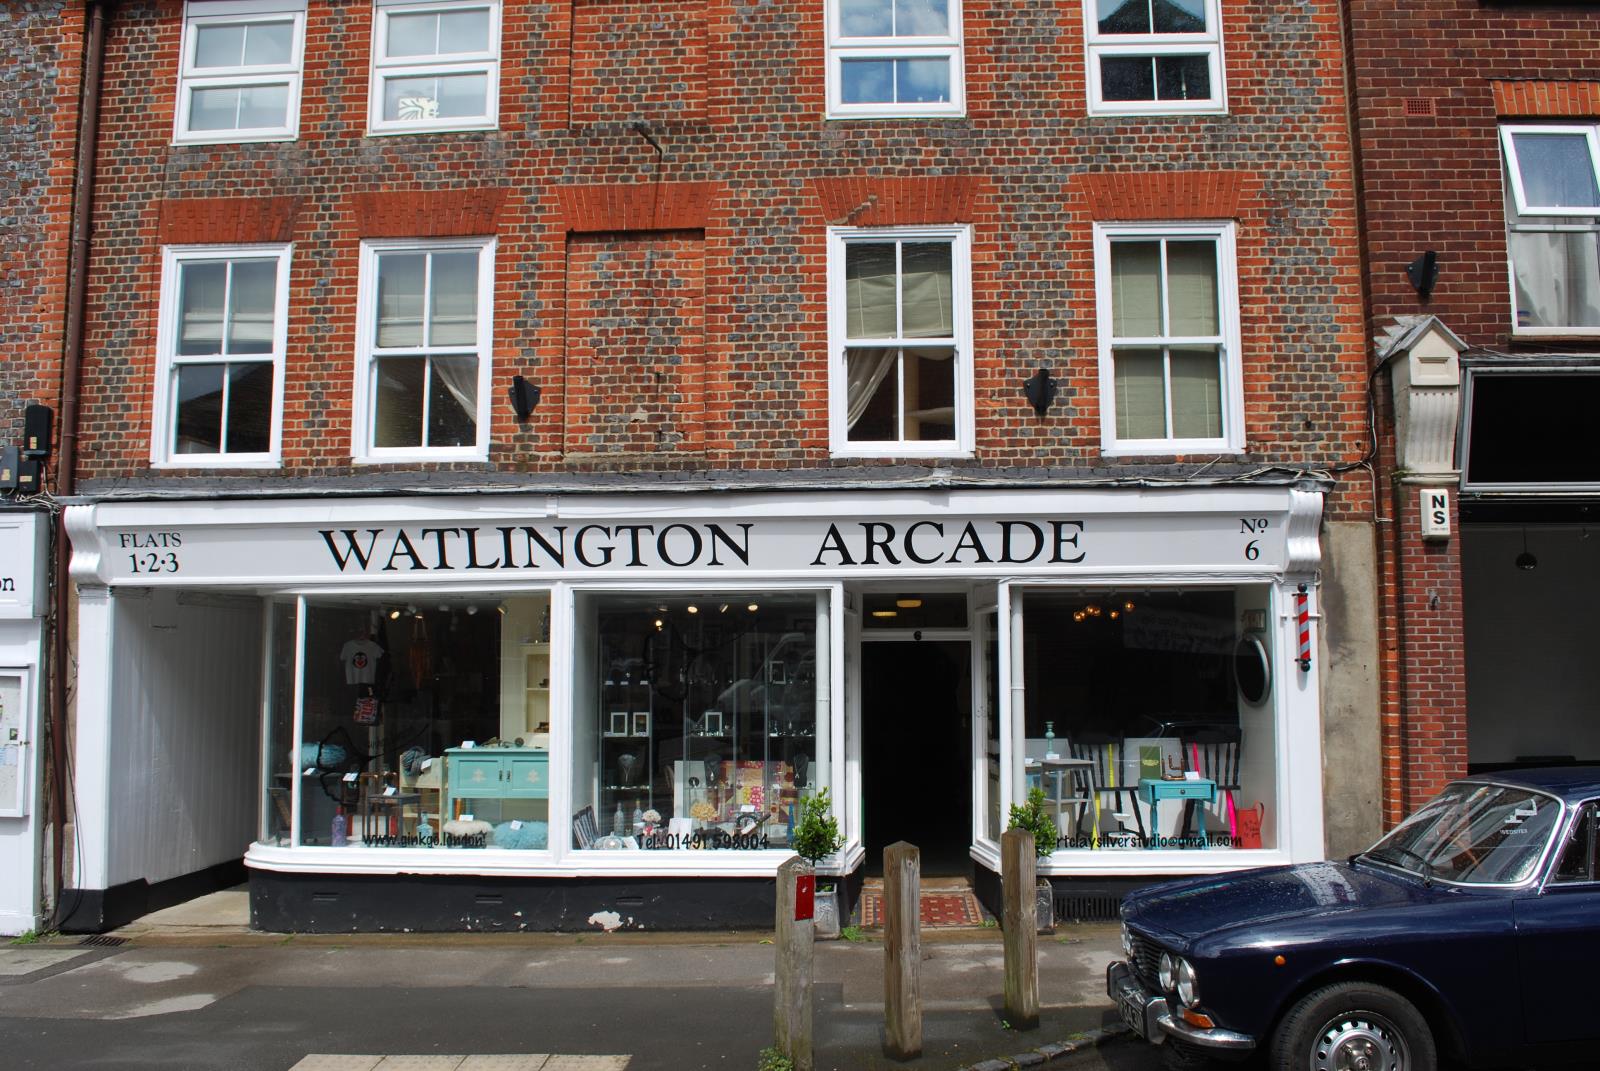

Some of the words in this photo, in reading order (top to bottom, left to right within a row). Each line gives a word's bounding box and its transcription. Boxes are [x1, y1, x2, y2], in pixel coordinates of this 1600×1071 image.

[119, 532, 182, 549] FLATS
[318, 523, 755, 572] WATLINGTON
[809, 520, 1086, 565] ARCADE
[1245, 539, 1260, 561] 6
[1054, 833, 1243, 850] rtclaysilverstudio@gmail.com
